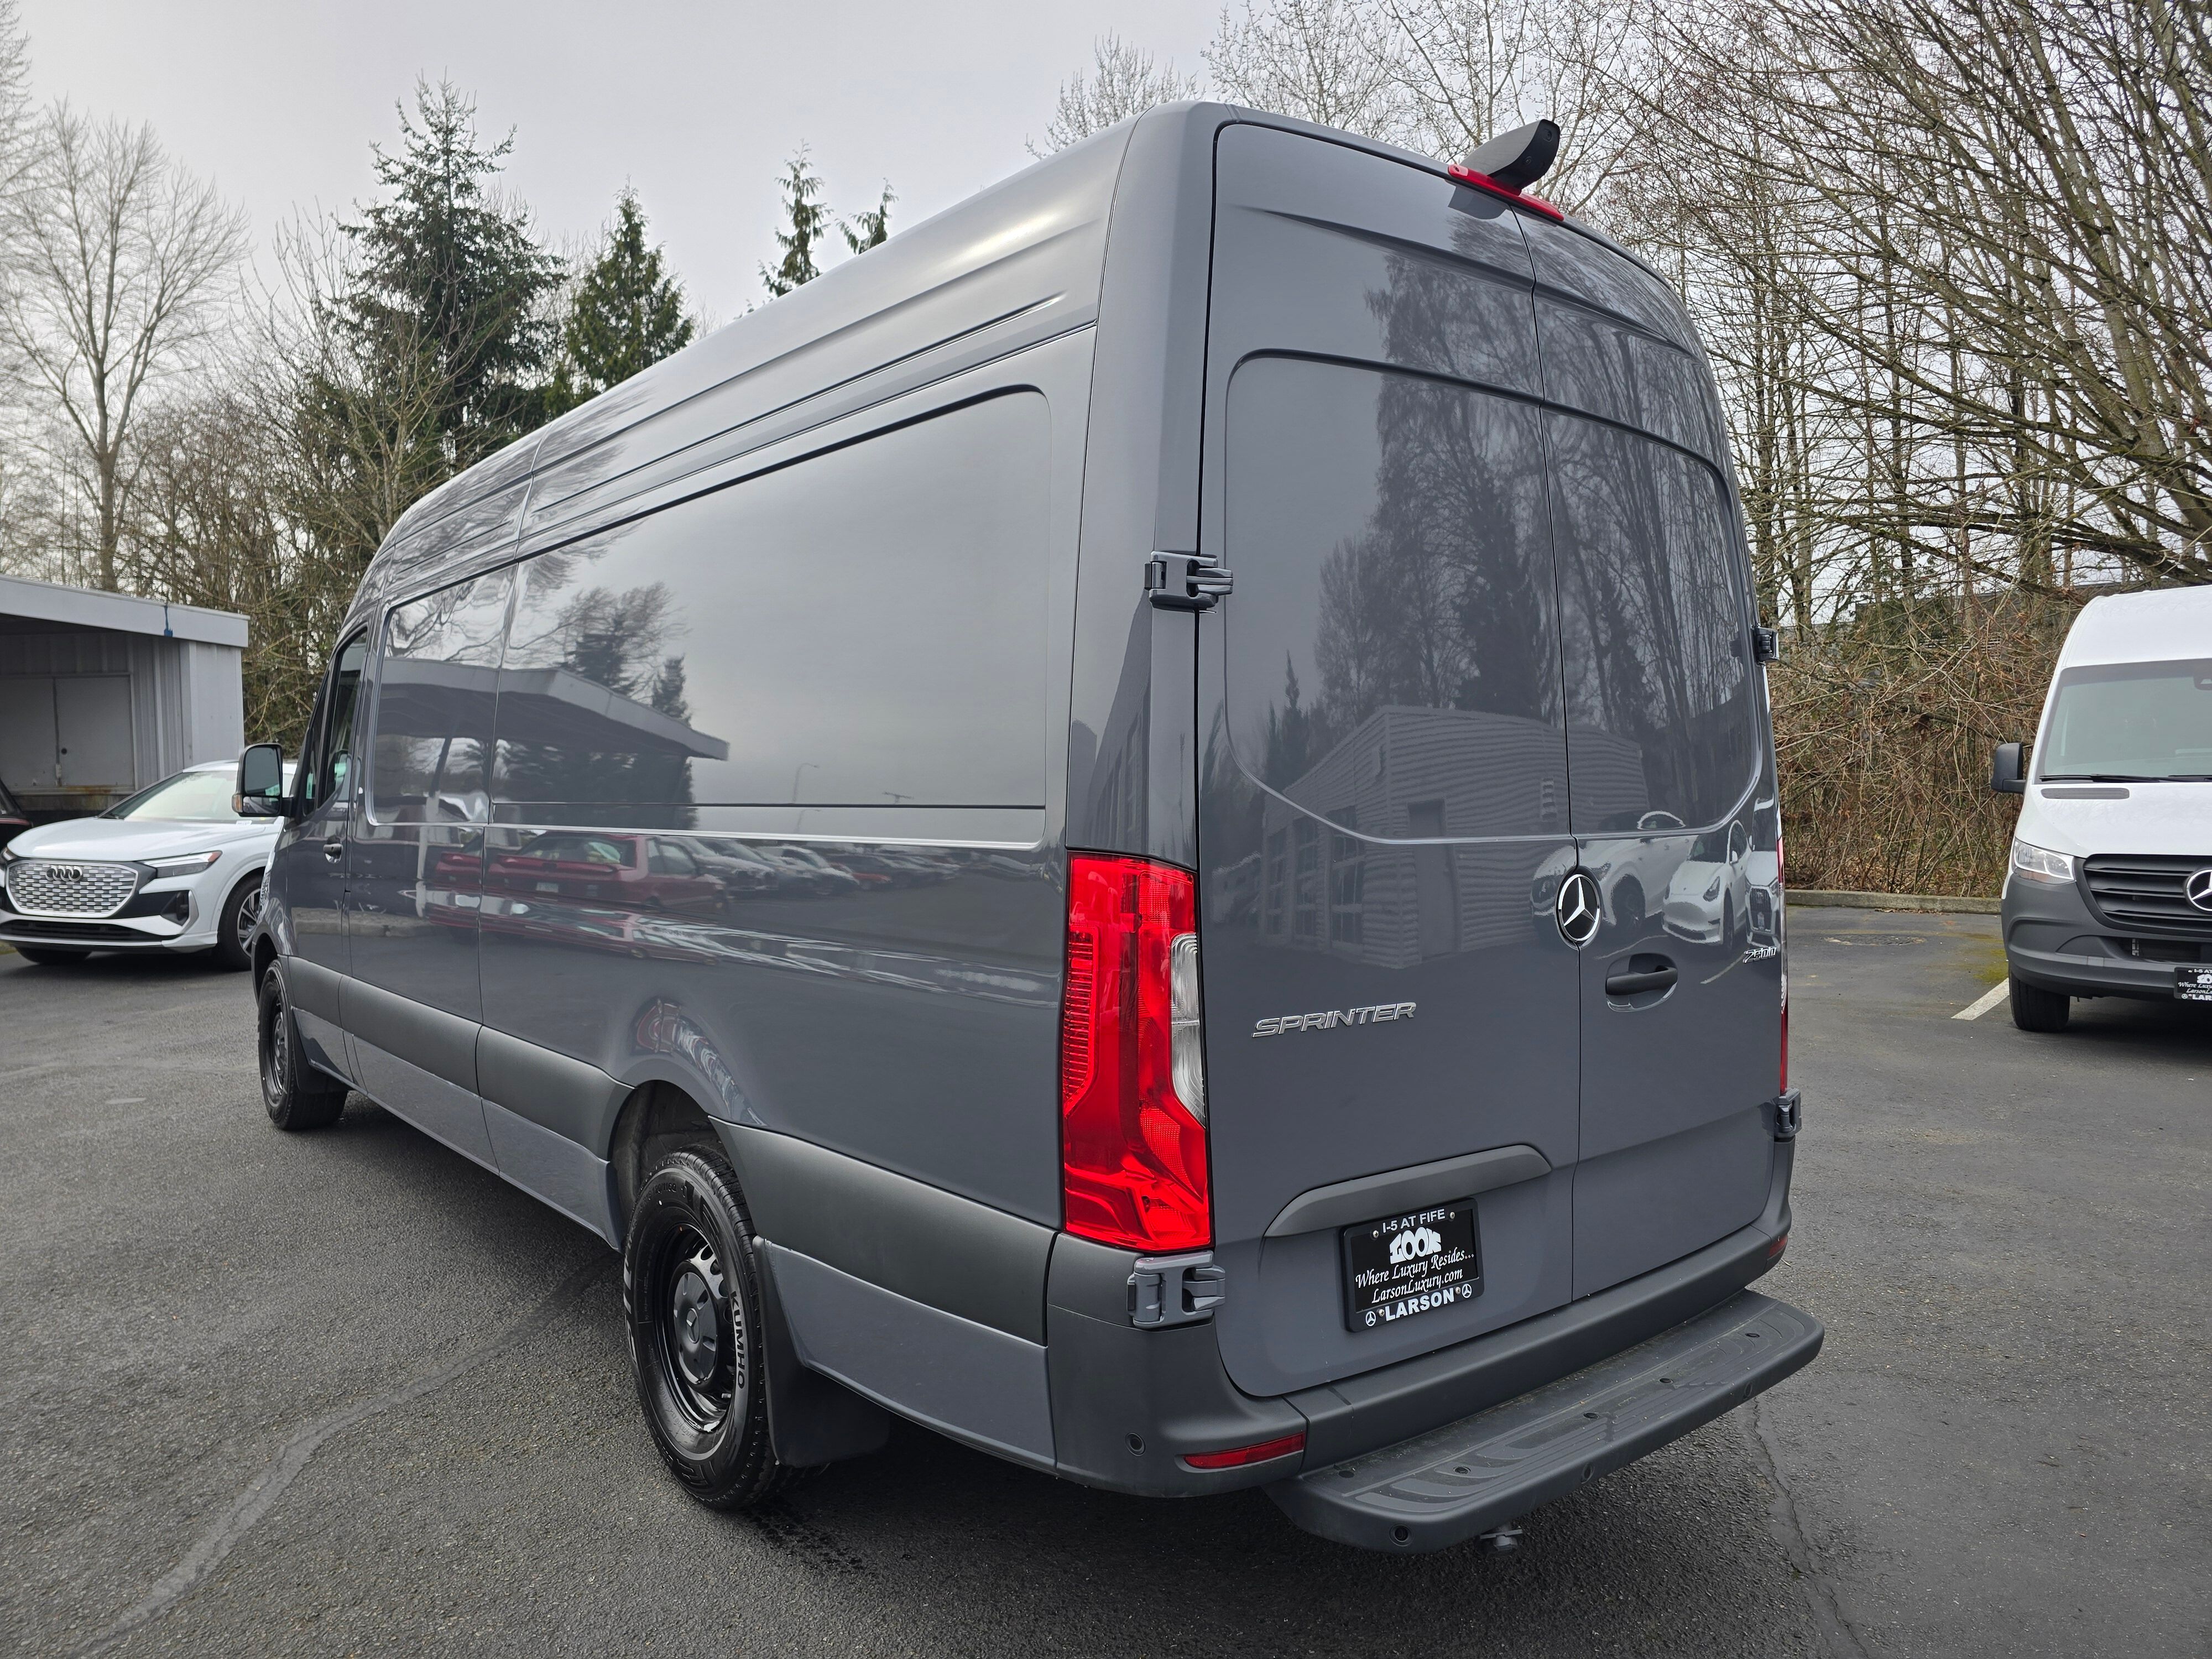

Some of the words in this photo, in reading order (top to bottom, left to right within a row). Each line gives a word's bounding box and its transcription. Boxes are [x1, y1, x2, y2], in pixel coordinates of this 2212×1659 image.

[1252, 1001, 1417, 1038] SPRINTER
[1383, 1220, 1398, 1233] I-5
[1400, 1215, 1416, 1229] AT
[1420, 1208, 1446, 1224] FIFE
[1389, 1227, 1442, 1264] LOOK
[1355, 1269, 1389, 1288] Where
[1391, 1260, 1428, 1279] Luxury
[1431, 1246, 1474, 1270] Resides...
[1371, 1269, 1463, 1303] LarsonLuxury.com
[1385, 1287, 1454, 1321] LARSON
[730, 1291, 745, 1389] KUMHO
